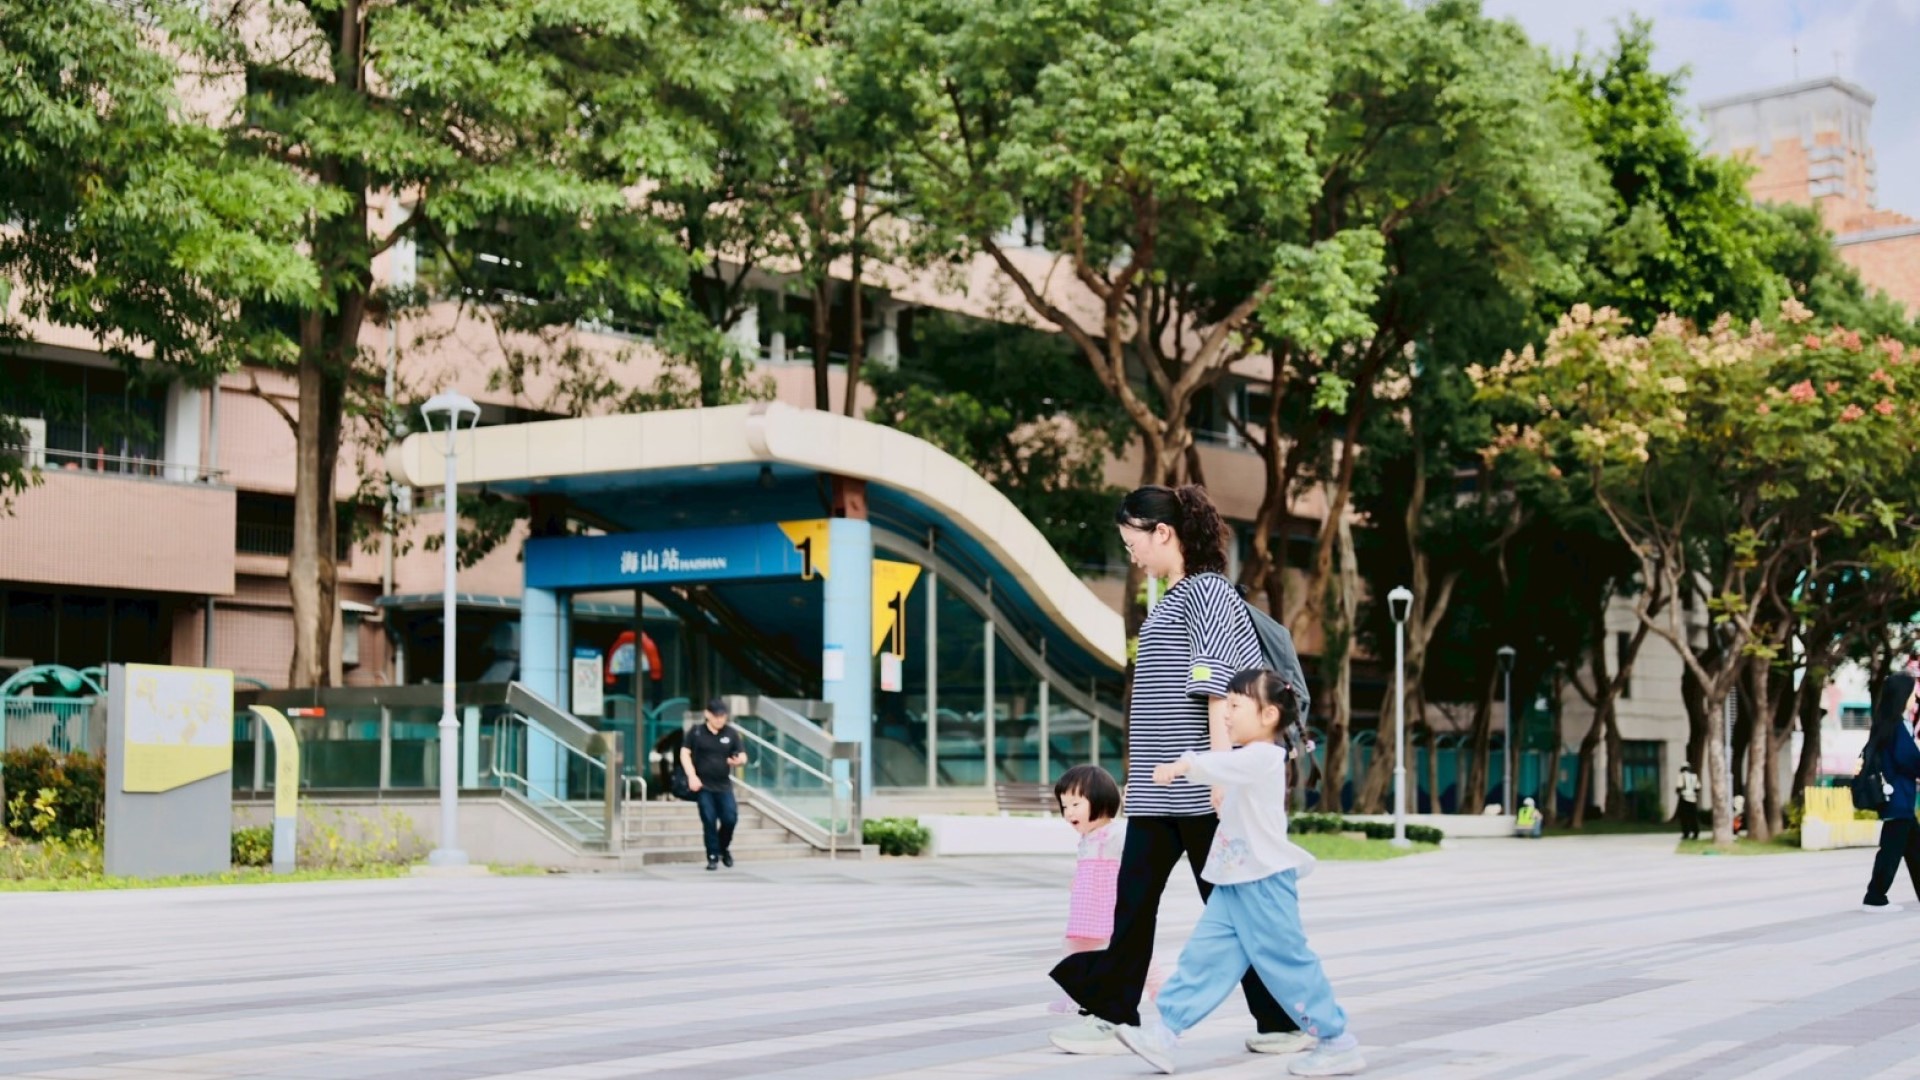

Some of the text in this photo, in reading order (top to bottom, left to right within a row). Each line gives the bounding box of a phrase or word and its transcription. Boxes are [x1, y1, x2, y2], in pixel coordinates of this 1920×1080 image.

[620, 547, 680, 574] 海山站
[795, 536, 813, 579] 1
[887, 590, 904, 659] 1
